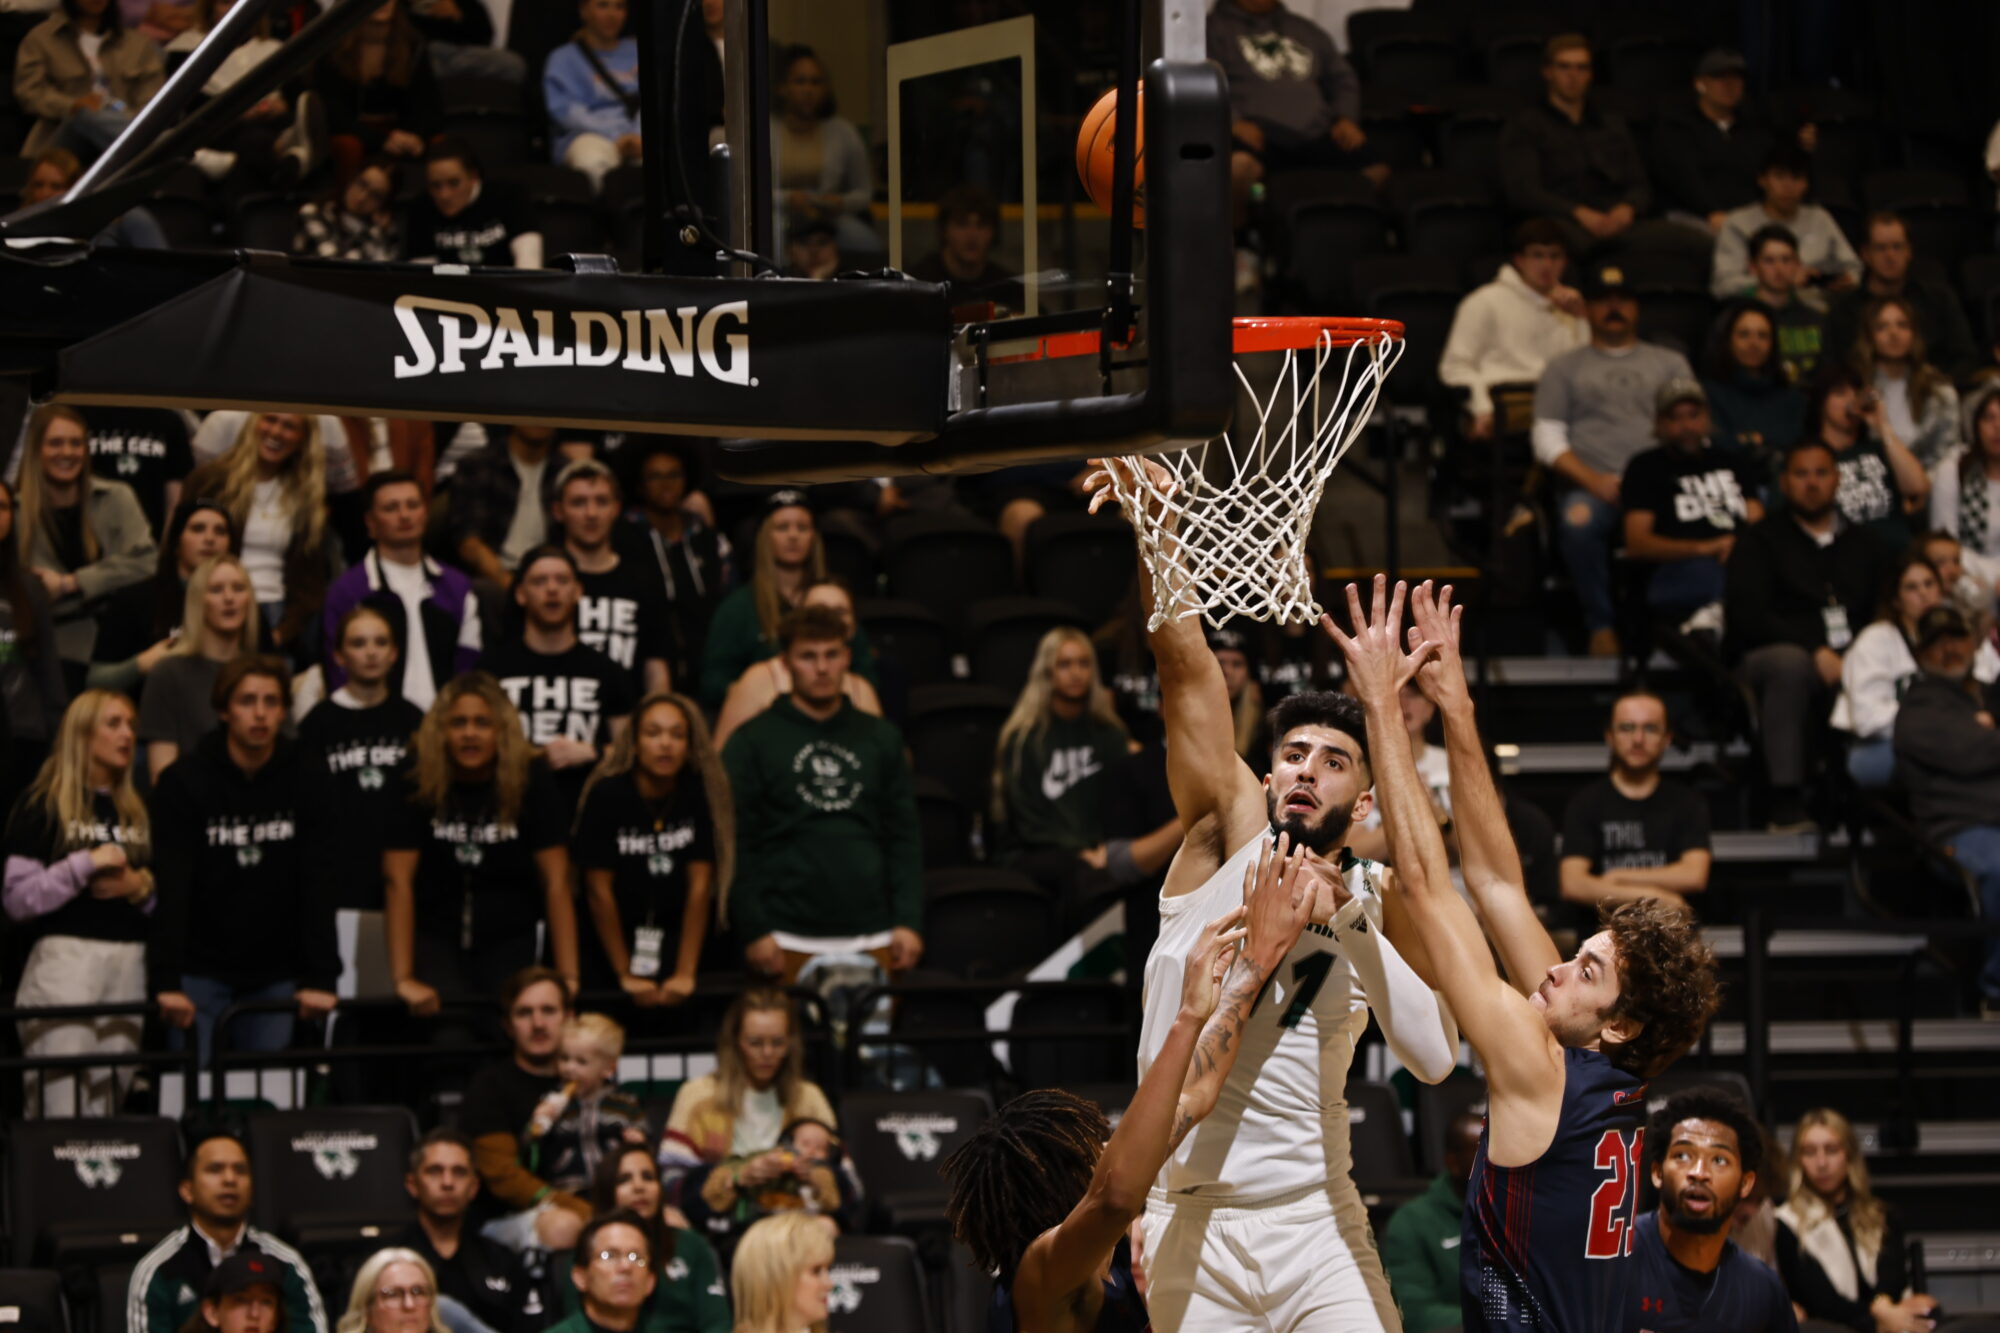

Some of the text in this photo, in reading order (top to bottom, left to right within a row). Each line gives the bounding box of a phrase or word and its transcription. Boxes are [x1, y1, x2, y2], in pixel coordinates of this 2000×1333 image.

[579, 596, 639, 634] HE
[498, 675, 601, 712] THE
[205, 825, 248, 846] THE
